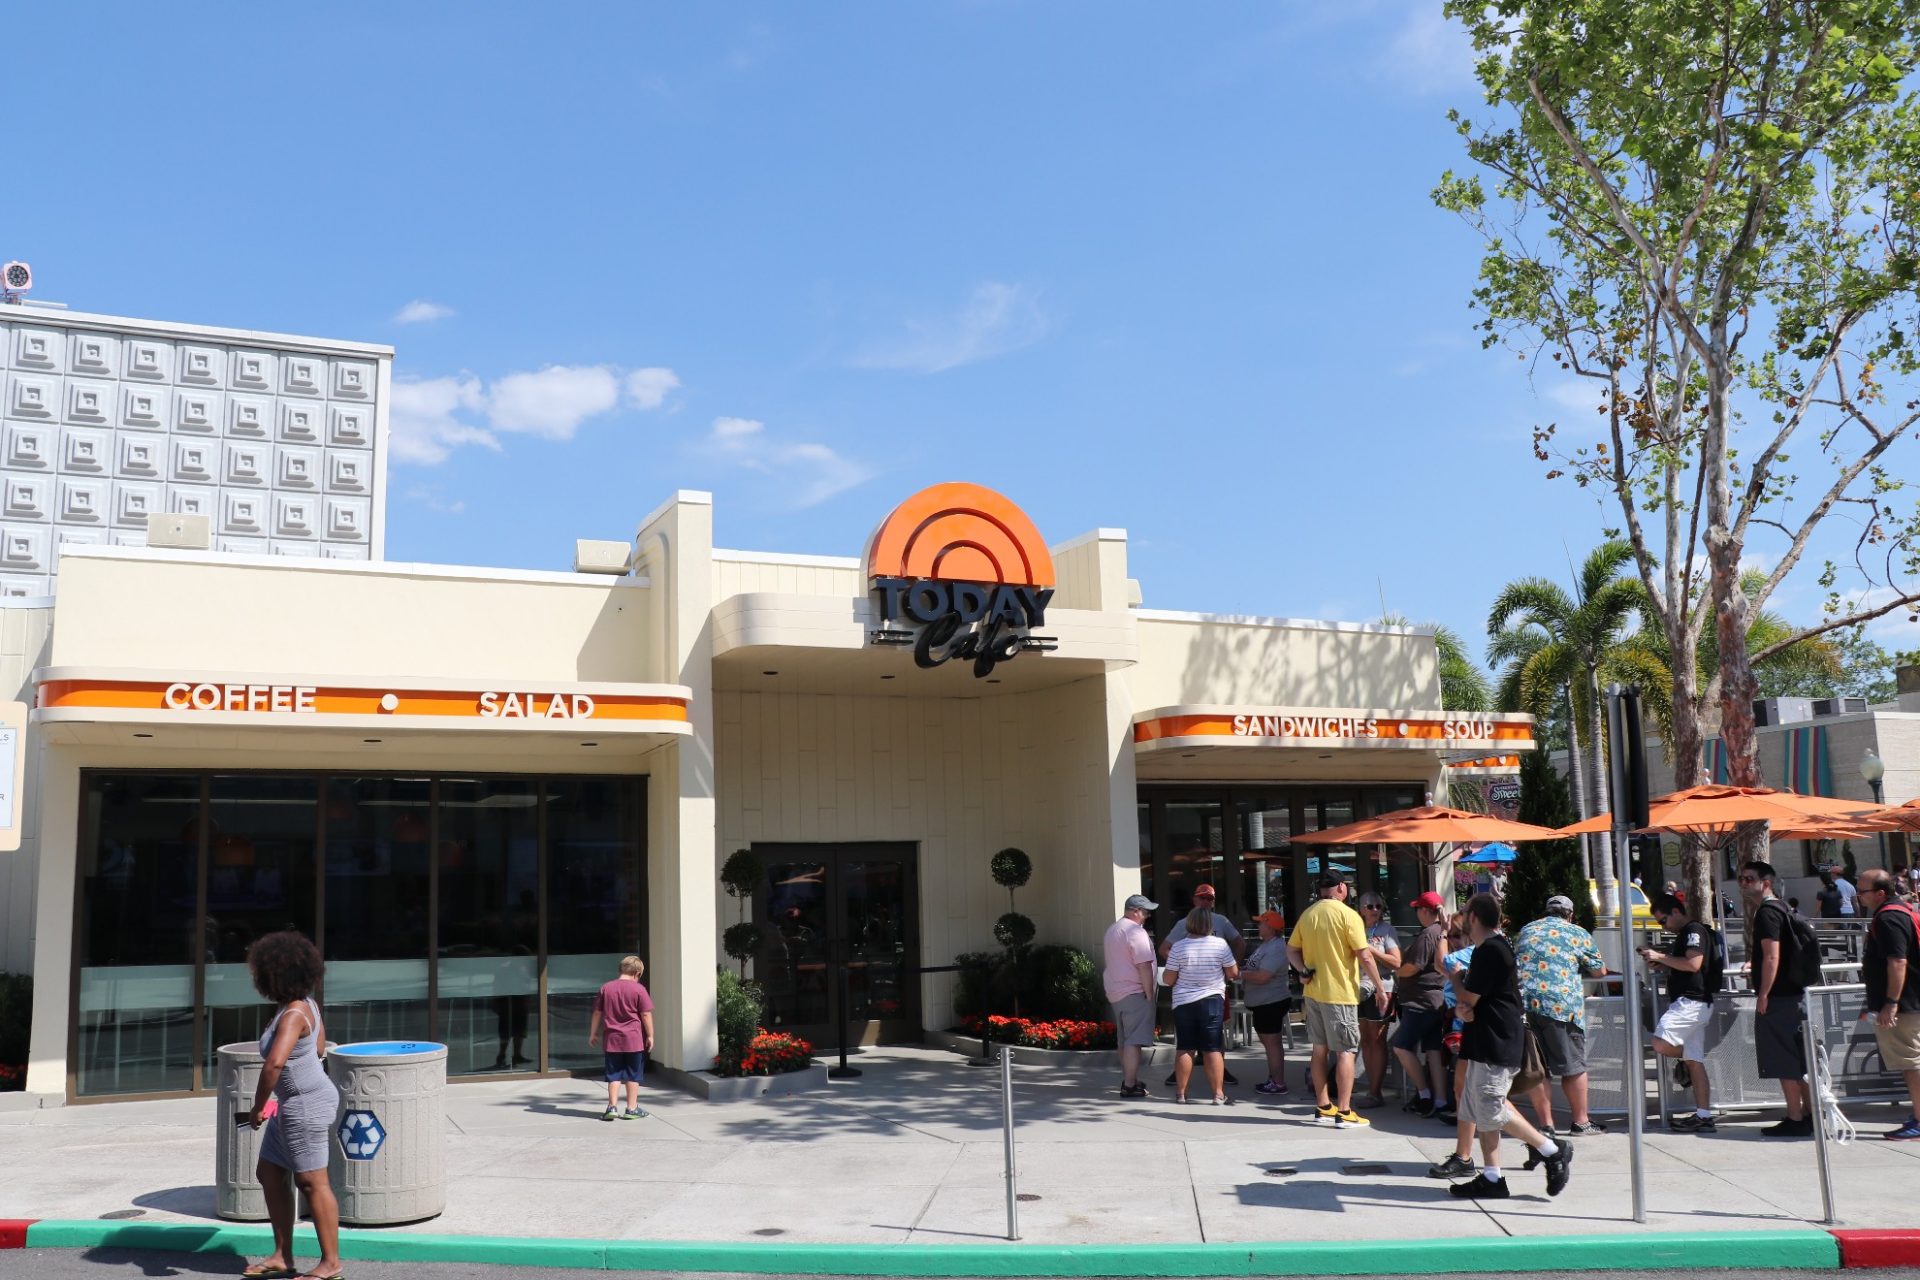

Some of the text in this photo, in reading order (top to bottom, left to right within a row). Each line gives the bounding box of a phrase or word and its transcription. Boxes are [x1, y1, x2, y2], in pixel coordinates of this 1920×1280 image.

[870, 578, 1055, 629] TODAY
[165, 682, 595, 719] COFFEE SALAD
[1233, 715, 1495, 740] SANDWICHES SOUP
